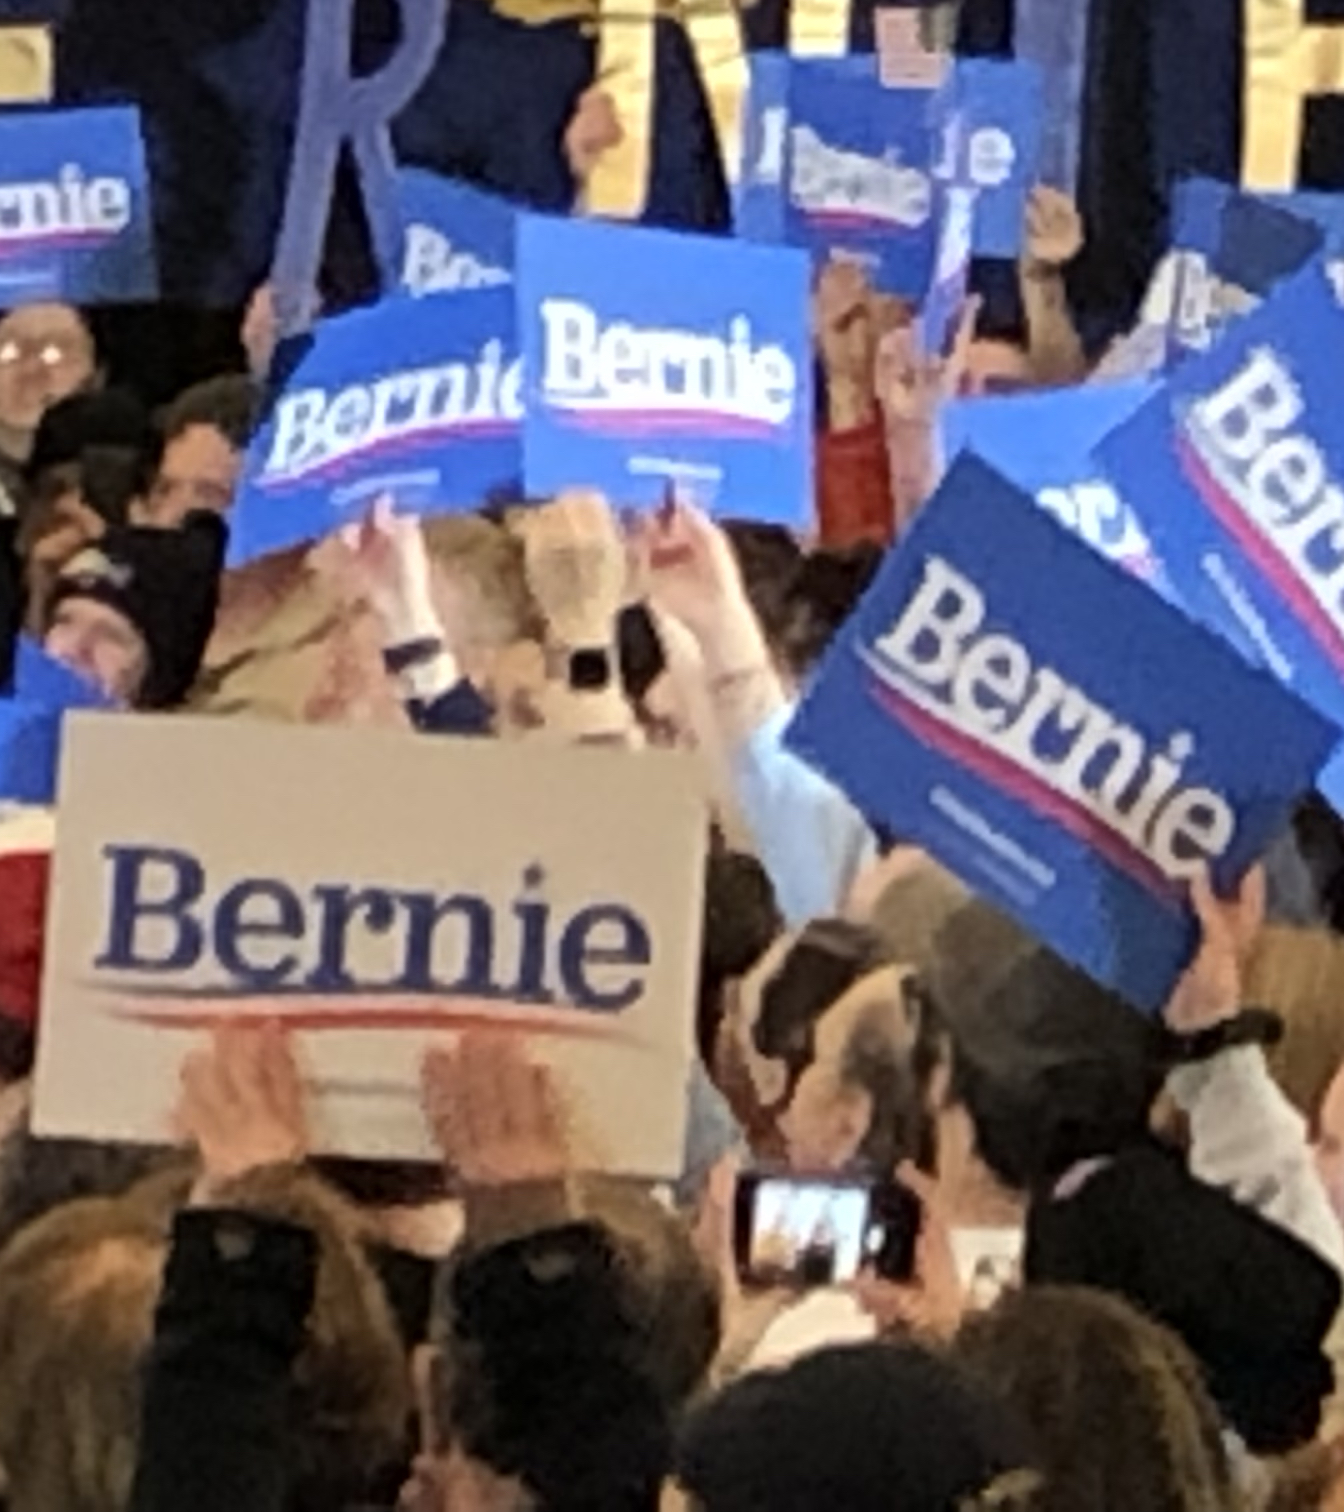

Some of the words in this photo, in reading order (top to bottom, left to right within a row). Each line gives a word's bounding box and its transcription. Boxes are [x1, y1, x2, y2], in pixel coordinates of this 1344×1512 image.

[540, 298, 797, 425] Bernie
[874, 554, 1236, 878] Bernie
[94, 842, 652, 1013] Bernie
